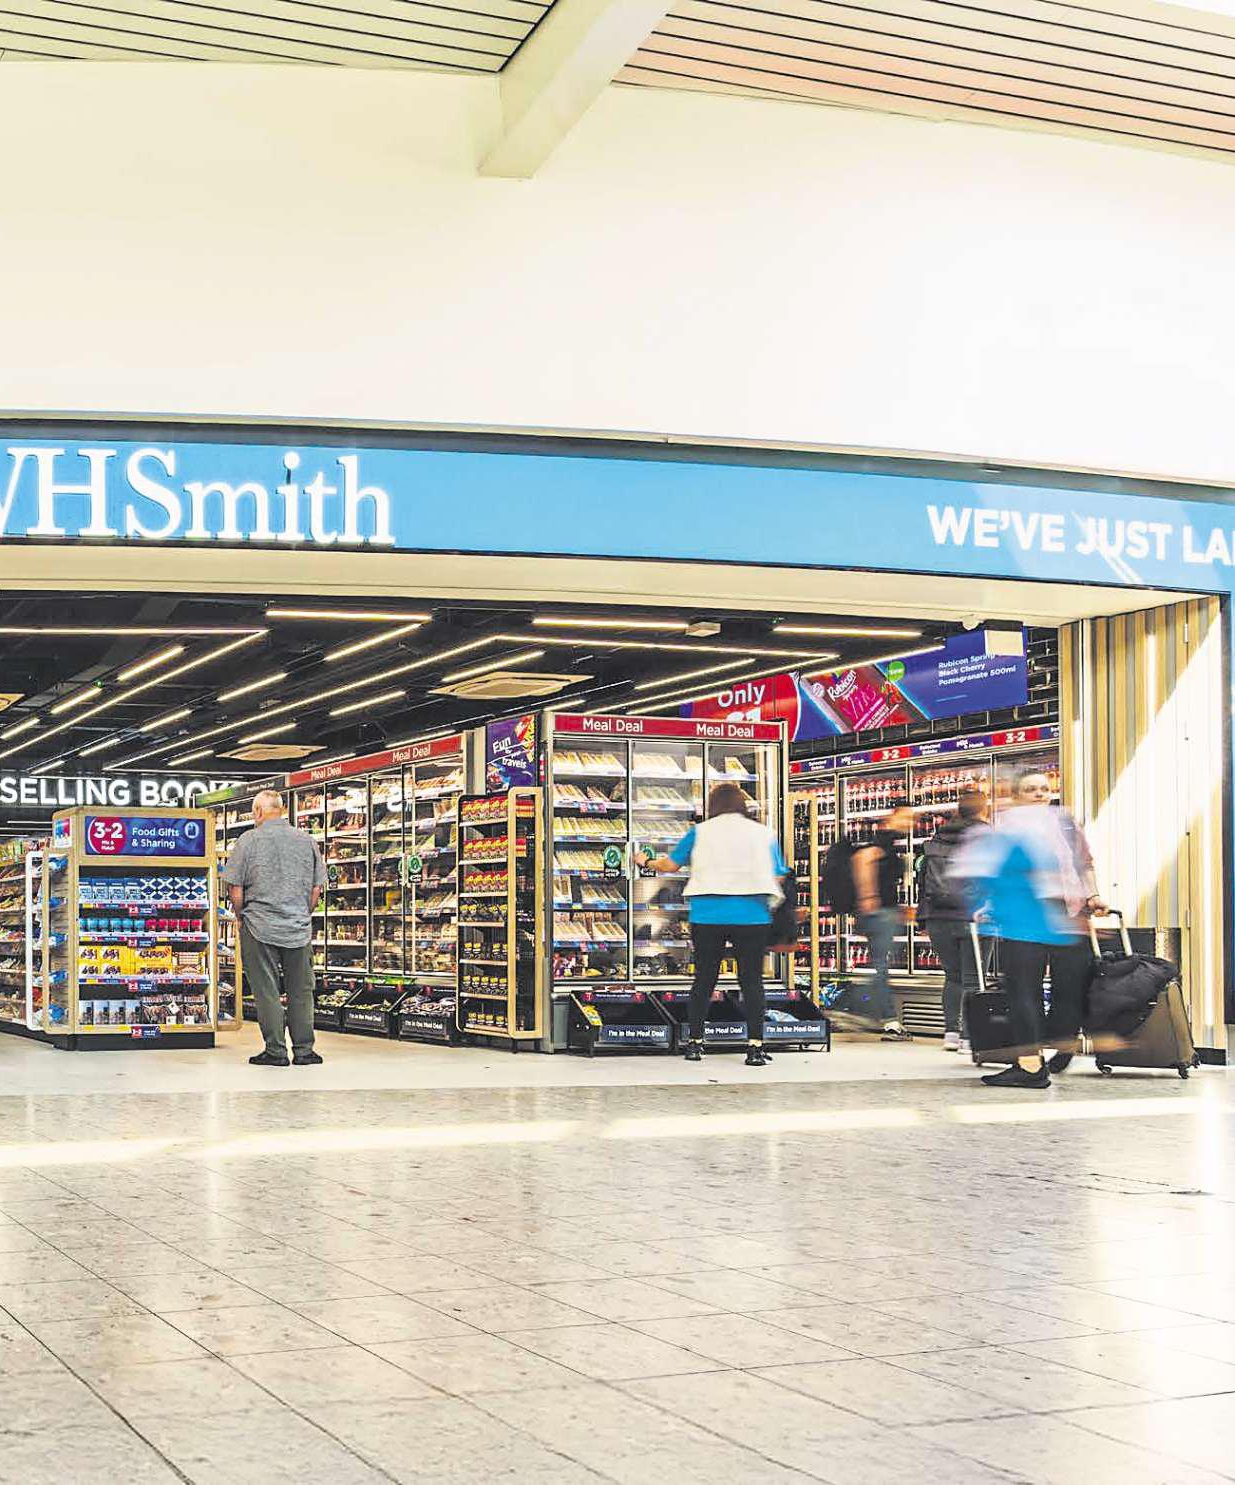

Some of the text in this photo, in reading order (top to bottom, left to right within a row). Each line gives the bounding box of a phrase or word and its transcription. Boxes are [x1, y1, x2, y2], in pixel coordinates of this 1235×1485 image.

[927, 504, 1235, 567] WE'VE JUST LA
[938, 657, 969, 669] Rubicon
[938, 662, 986, 677] Black Cherry
[989, 664, 1016, 676] 500ml
[717, 682, 765, 708] Only
[582, 718, 643, 732] Meal Deal
[696, 723, 754, 738] Meal Deal
[492, 736, 512, 754] Fun
[392, 744, 431, 763] Meal Deal
[501, 757, 527, 769] travels
[310, 764, 342, 780] Meal Deal
[93, 821, 106, 839] 3
[110, 822, 124, 839] 2
[132, 827, 180, 837] Food Gifts
[131, 838, 176, 850] & Sharing
